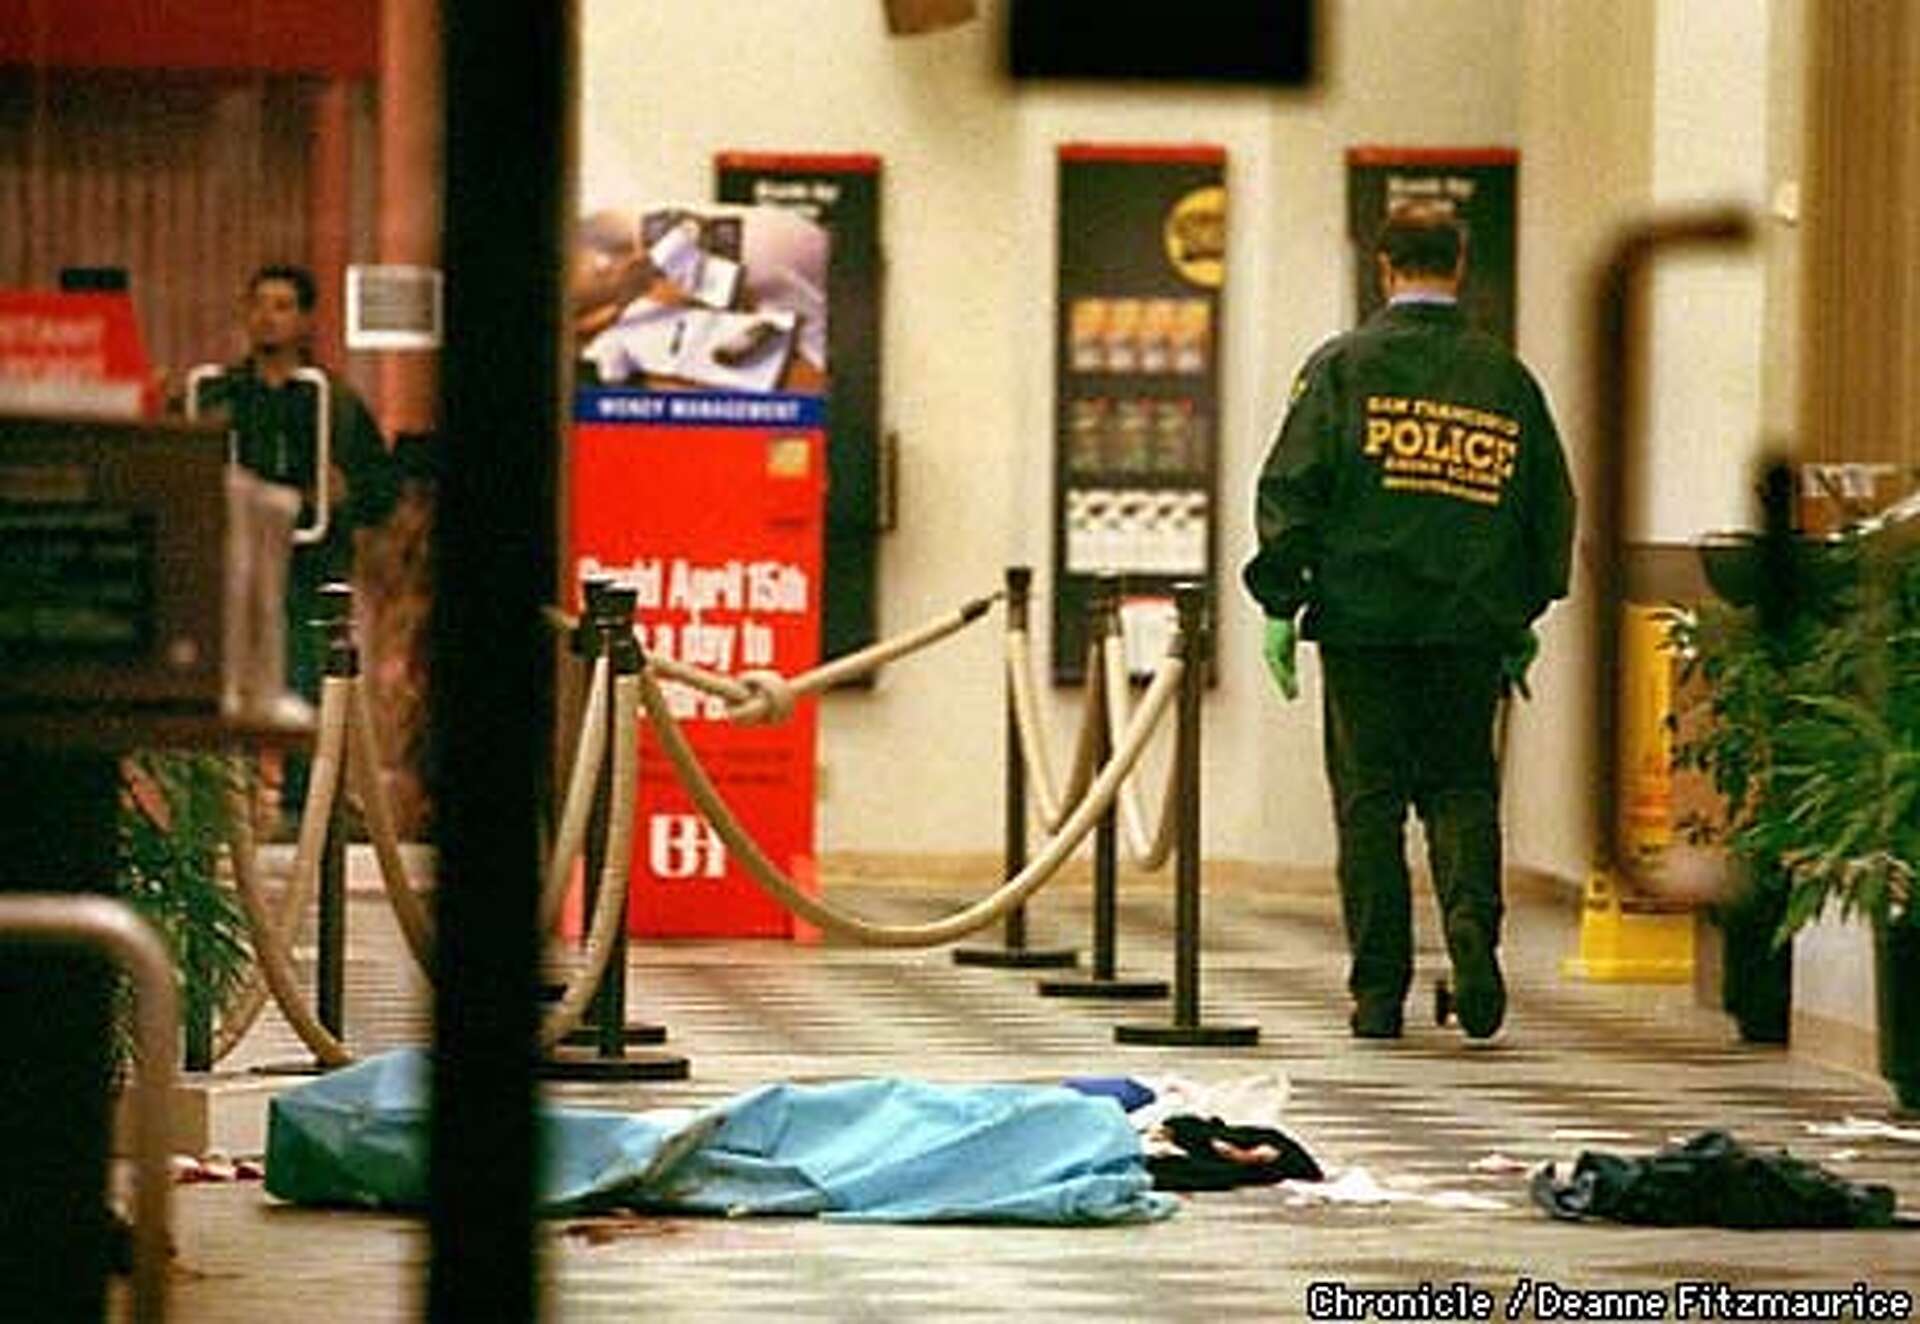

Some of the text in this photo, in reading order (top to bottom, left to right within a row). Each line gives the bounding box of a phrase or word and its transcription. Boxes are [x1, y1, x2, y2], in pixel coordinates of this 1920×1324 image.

[1367, 396, 1409, 413] SAN
[1362, 417, 1518, 479] POLICE
[667, 558, 744, 622] April
[748, 560, 808, 614] 15th
